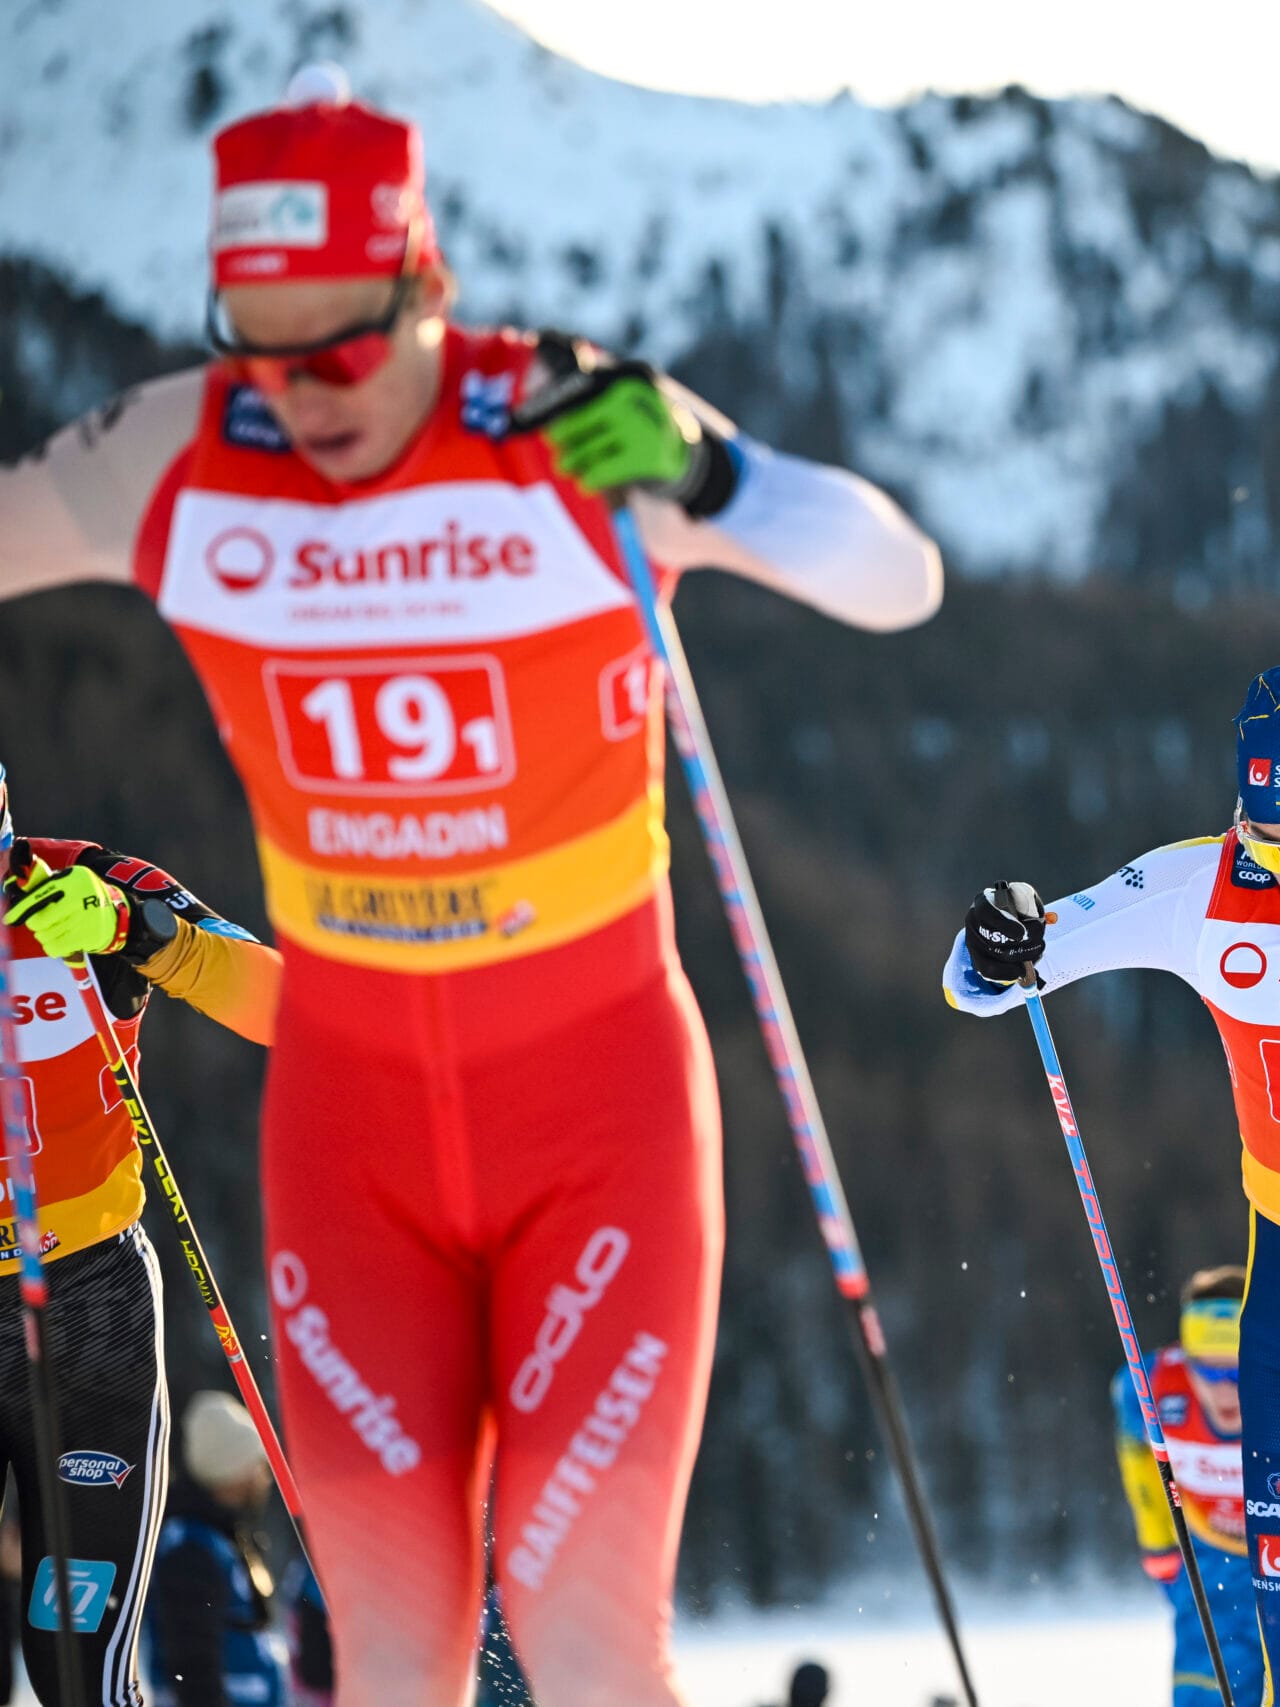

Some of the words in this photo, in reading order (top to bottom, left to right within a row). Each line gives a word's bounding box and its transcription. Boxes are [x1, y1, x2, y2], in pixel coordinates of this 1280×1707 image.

[289, 521, 536, 590] Sunrise
[307, 804, 508, 860] ENGADIN
[1238, 870, 1271, 885] coop
[286, 1305, 421, 1476] Sunrise
[59, 1458, 120, 1472] personal
[69, 1467, 104, 1480] shop
[507, 1331, 668, 1592] RAIFFEISEN
